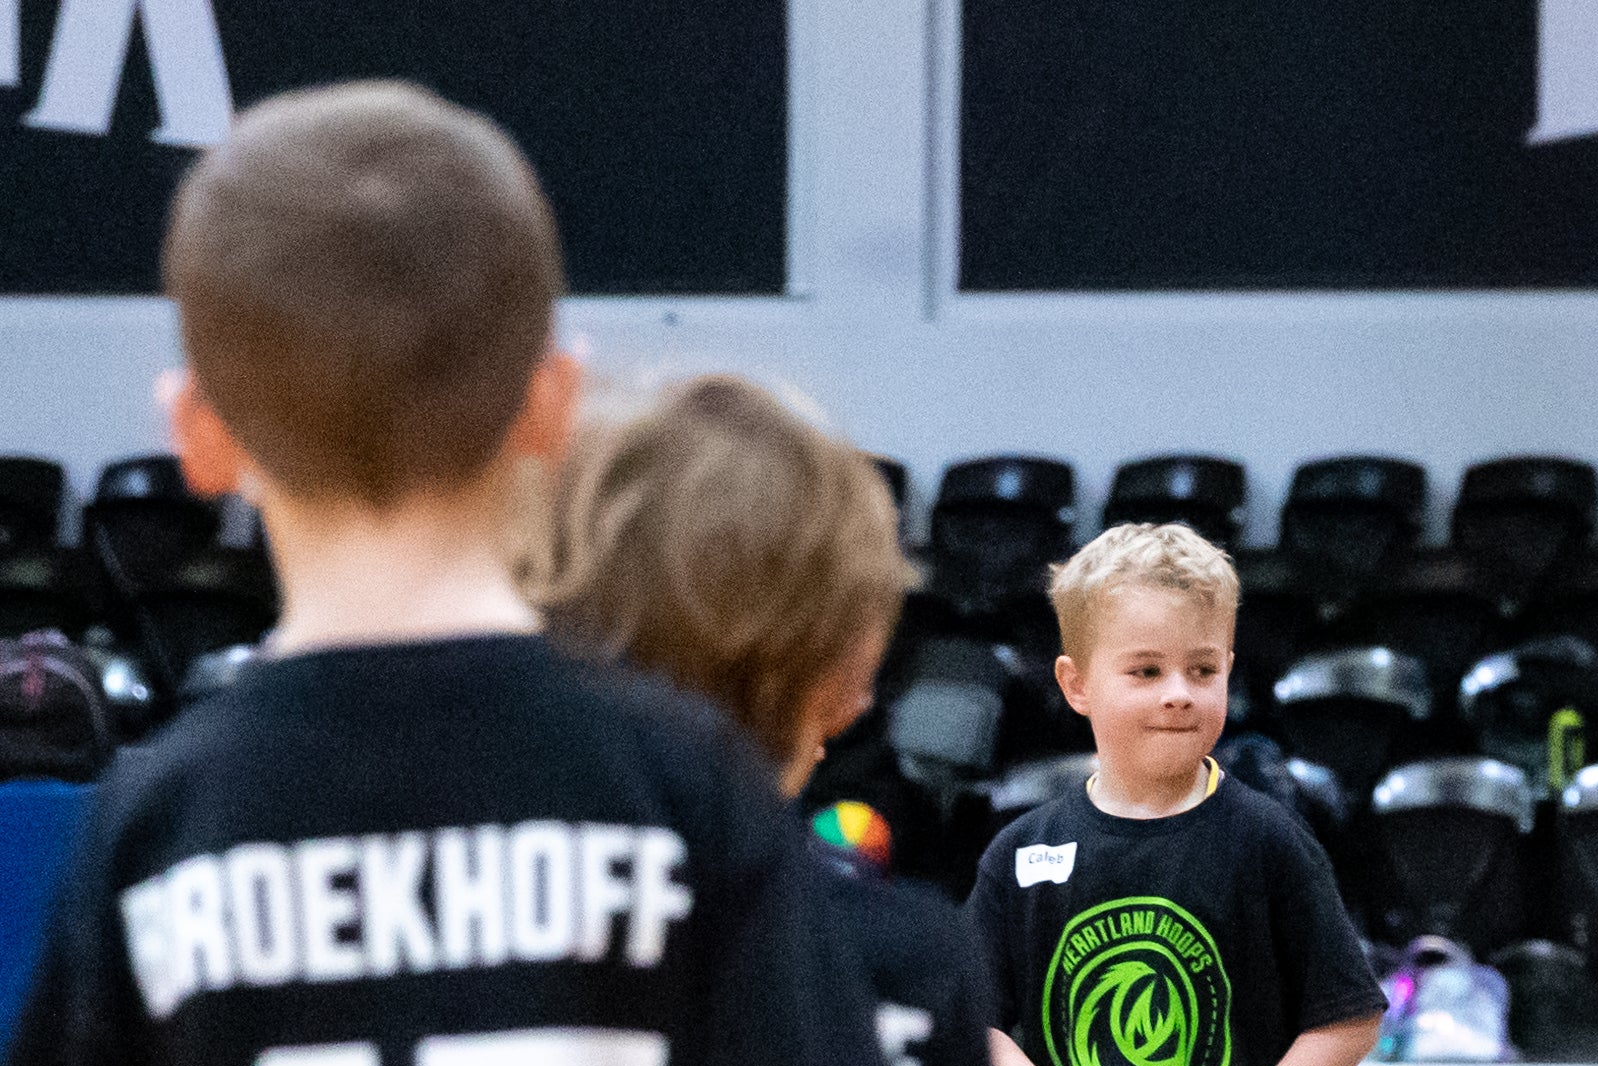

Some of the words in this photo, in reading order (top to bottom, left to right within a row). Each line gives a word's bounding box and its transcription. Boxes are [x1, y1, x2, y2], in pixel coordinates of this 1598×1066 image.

[1028, 851, 1064, 865] Caleb
[1062, 911, 1155, 976] HEARTLAND
[1156, 914, 1213, 974] HOOPS
